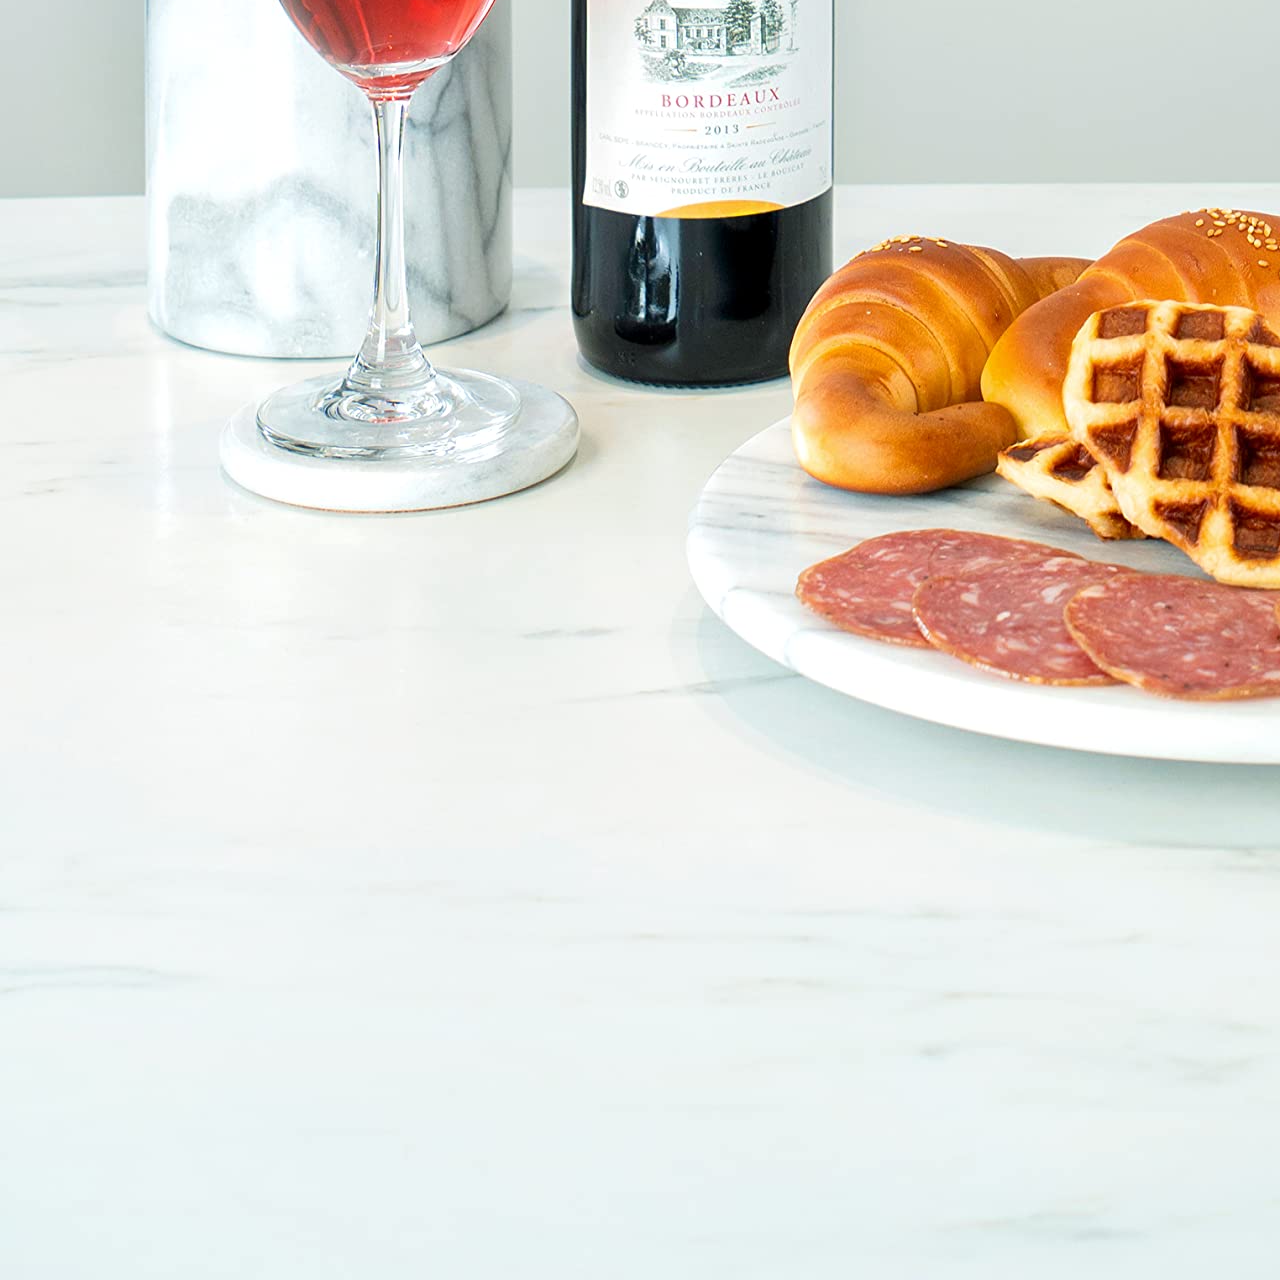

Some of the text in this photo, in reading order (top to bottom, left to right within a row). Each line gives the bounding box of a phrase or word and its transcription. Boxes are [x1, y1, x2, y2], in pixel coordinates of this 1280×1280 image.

[661, 87, 780, 109] BORDEAUX
[635, 109, 696, 119] APPELLATION
[700, 109, 751, 119] BORDEAUX
[704, 124, 739, 136] 2013
[619, 153, 654, 171] Mis
[658, 164, 676, 172] en
[679, 156, 747, 173] Bouteille
[749, 160, 767, 169] au
[631, 173, 647, 182] PAR
[650, 175, 710, 185] SEIGNOURET
[671, 182, 771, 195] PRODUCT DE FRANCE
